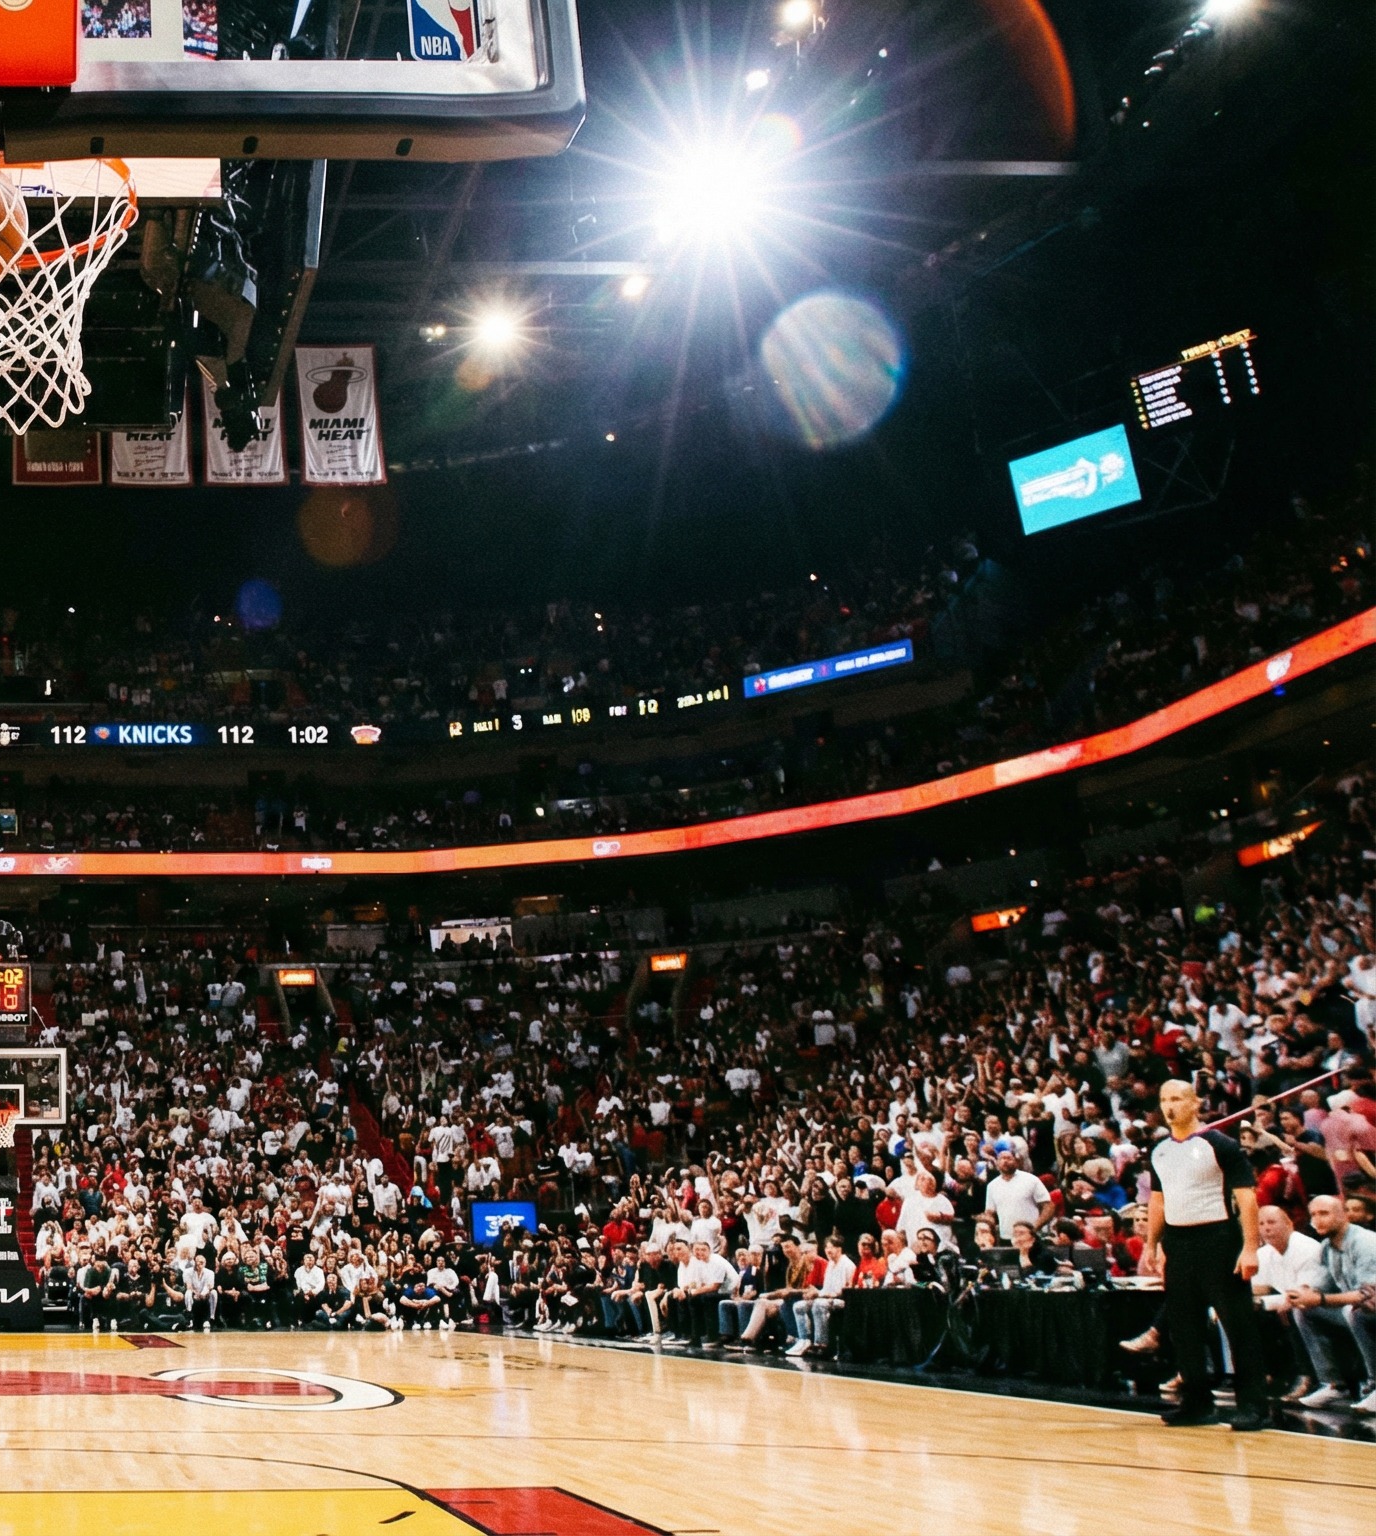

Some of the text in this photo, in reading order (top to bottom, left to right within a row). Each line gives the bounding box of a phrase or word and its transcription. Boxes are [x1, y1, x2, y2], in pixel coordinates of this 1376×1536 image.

[420, 36, 452, 55] NBA
[309, 417, 365, 429] MIAMI
[317, 429, 370, 441] HEAT
[50, 725, 328, 744] 112 KNICKS 112 1:02
